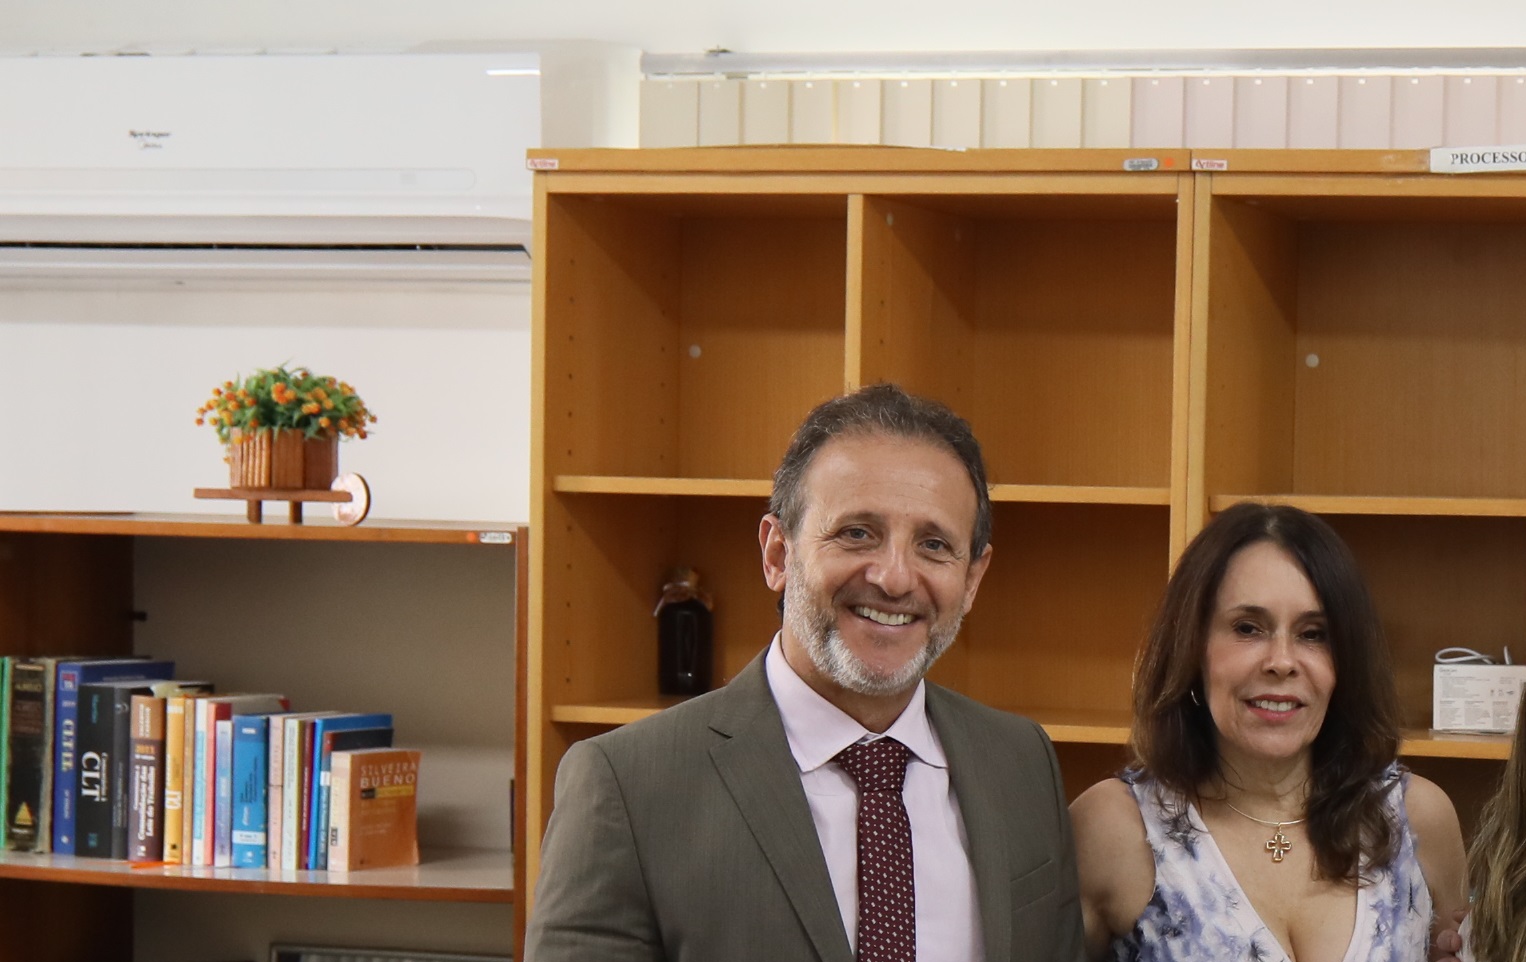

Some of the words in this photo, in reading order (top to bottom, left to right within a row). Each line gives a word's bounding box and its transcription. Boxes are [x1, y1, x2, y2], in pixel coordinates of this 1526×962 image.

[81, 751, 101, 802] CLT
[360, 762, 416, 776] SILVEIRA
[360, 773, 415, 789] BUENO
